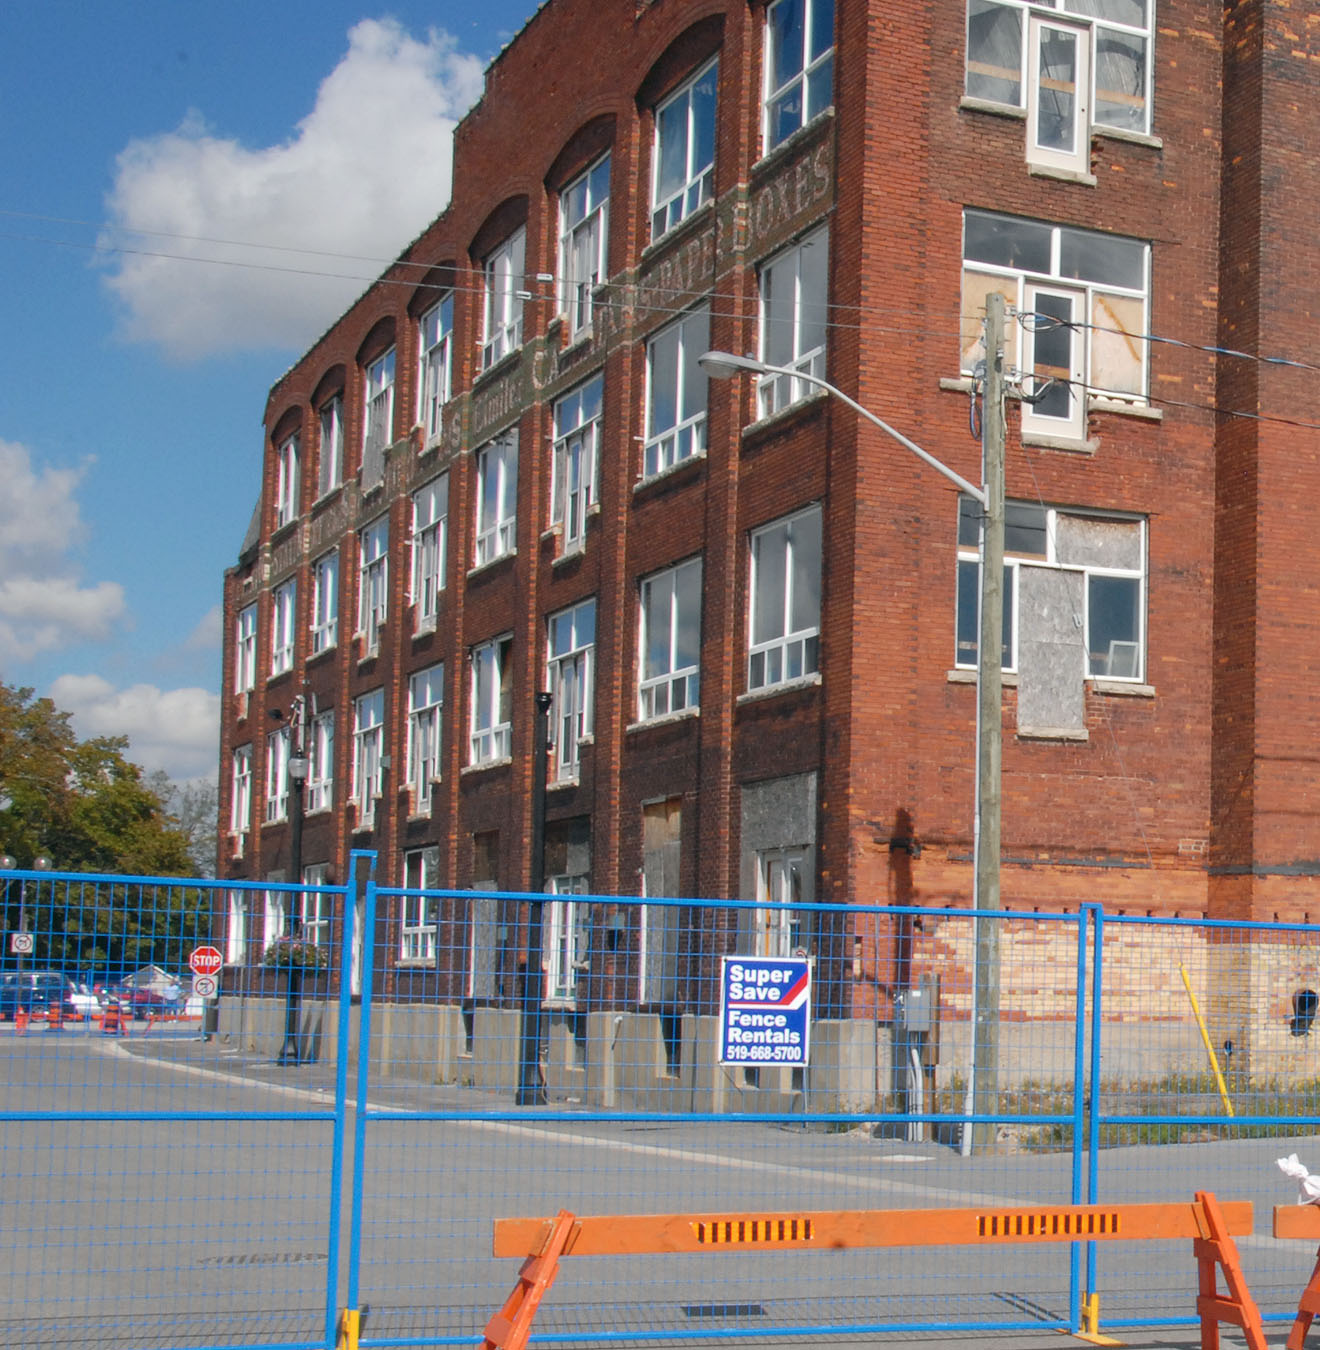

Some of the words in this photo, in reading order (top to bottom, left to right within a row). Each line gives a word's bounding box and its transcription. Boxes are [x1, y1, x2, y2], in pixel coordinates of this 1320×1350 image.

[194, 955, 220, 967] STOP
[730, 965, 792, 986] Super
[728, 982, 781, 1001] Save
[728, 1011, 787, 1027] Fence
[727, 1027, 801, 1044] Rentals
[726, 1045, 801, 1060] 519-668-5700
